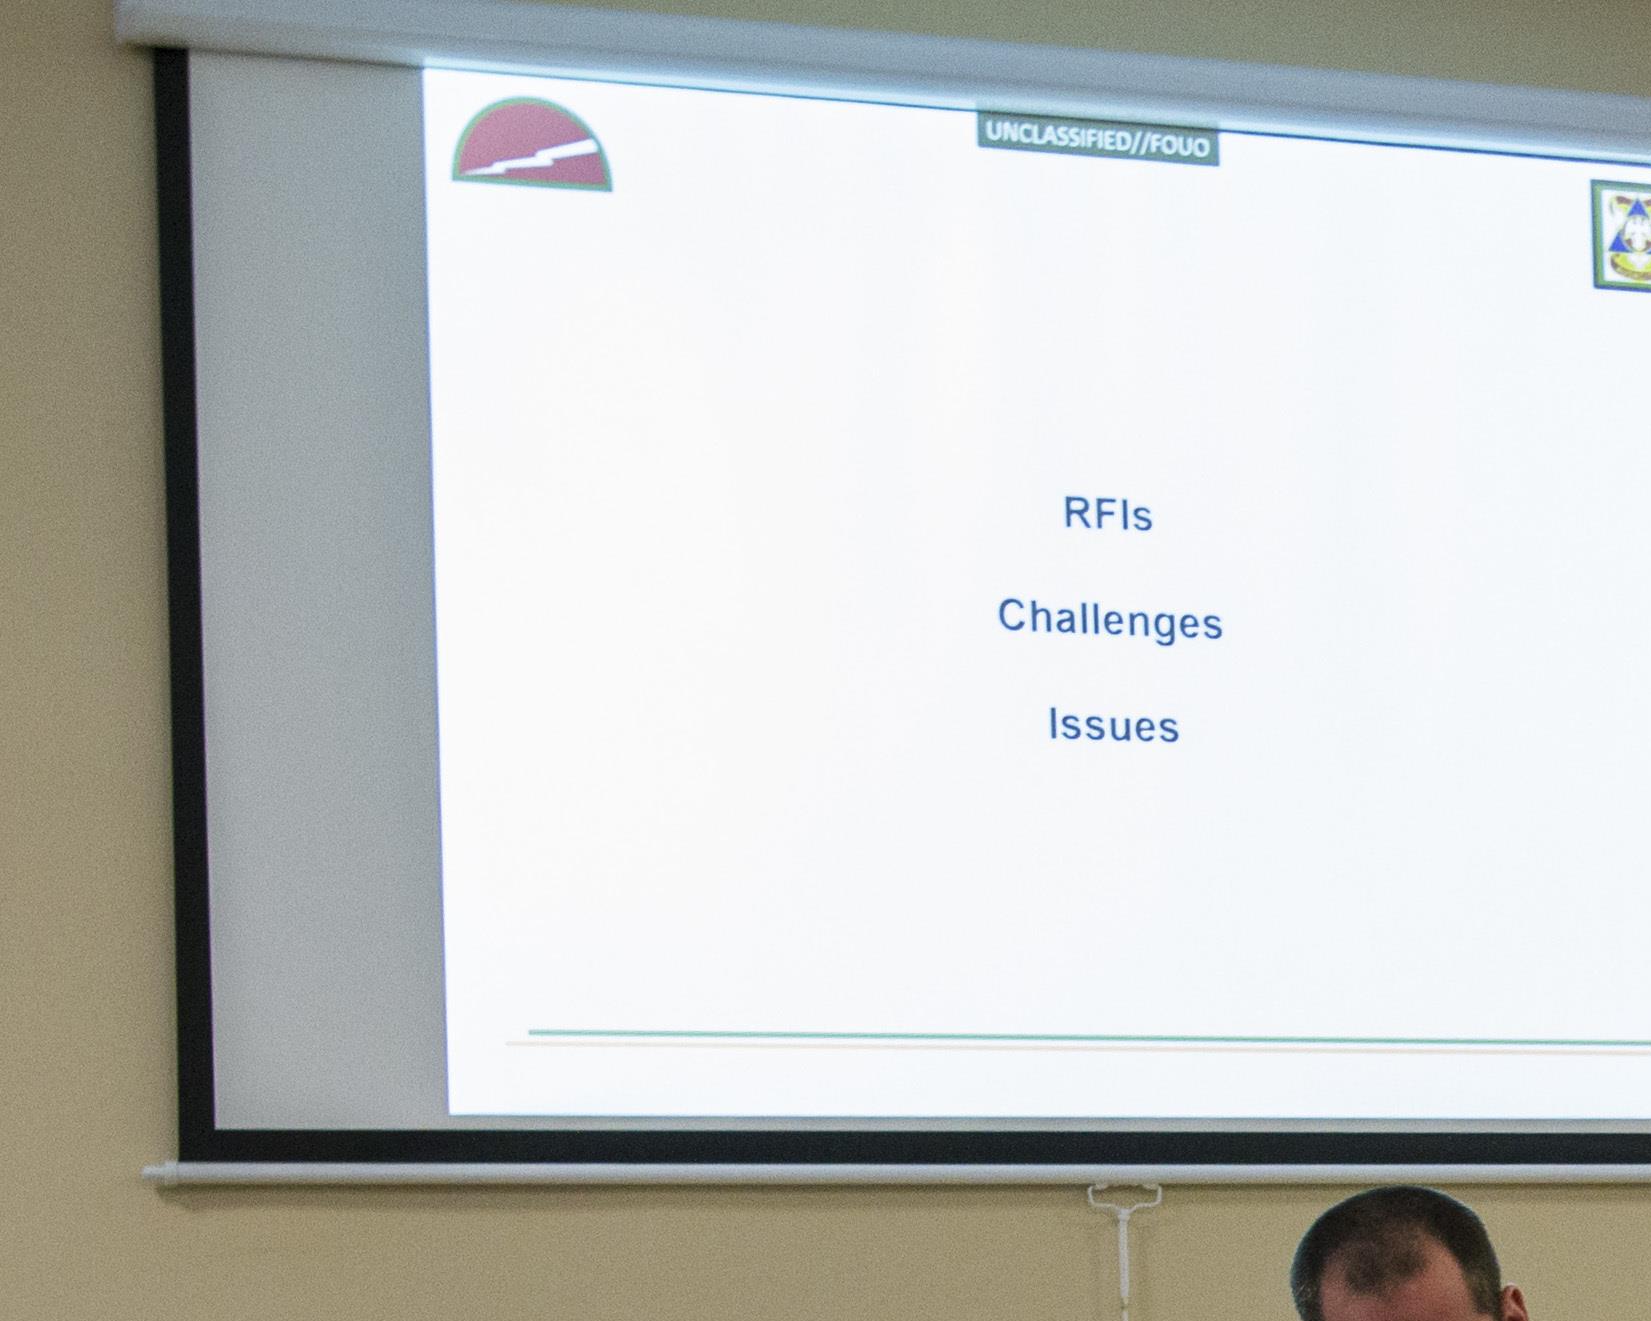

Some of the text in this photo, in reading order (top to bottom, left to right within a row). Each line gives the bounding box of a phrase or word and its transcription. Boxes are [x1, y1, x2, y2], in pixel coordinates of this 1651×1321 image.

[985, 120, 1210, 158] UNCLASSIFIED//FOUO
[1065, 496, 1152, 531] RFIs
[999, 598, 1222, 646] Challenges
[1050, 707, 1179, 743] Issues
